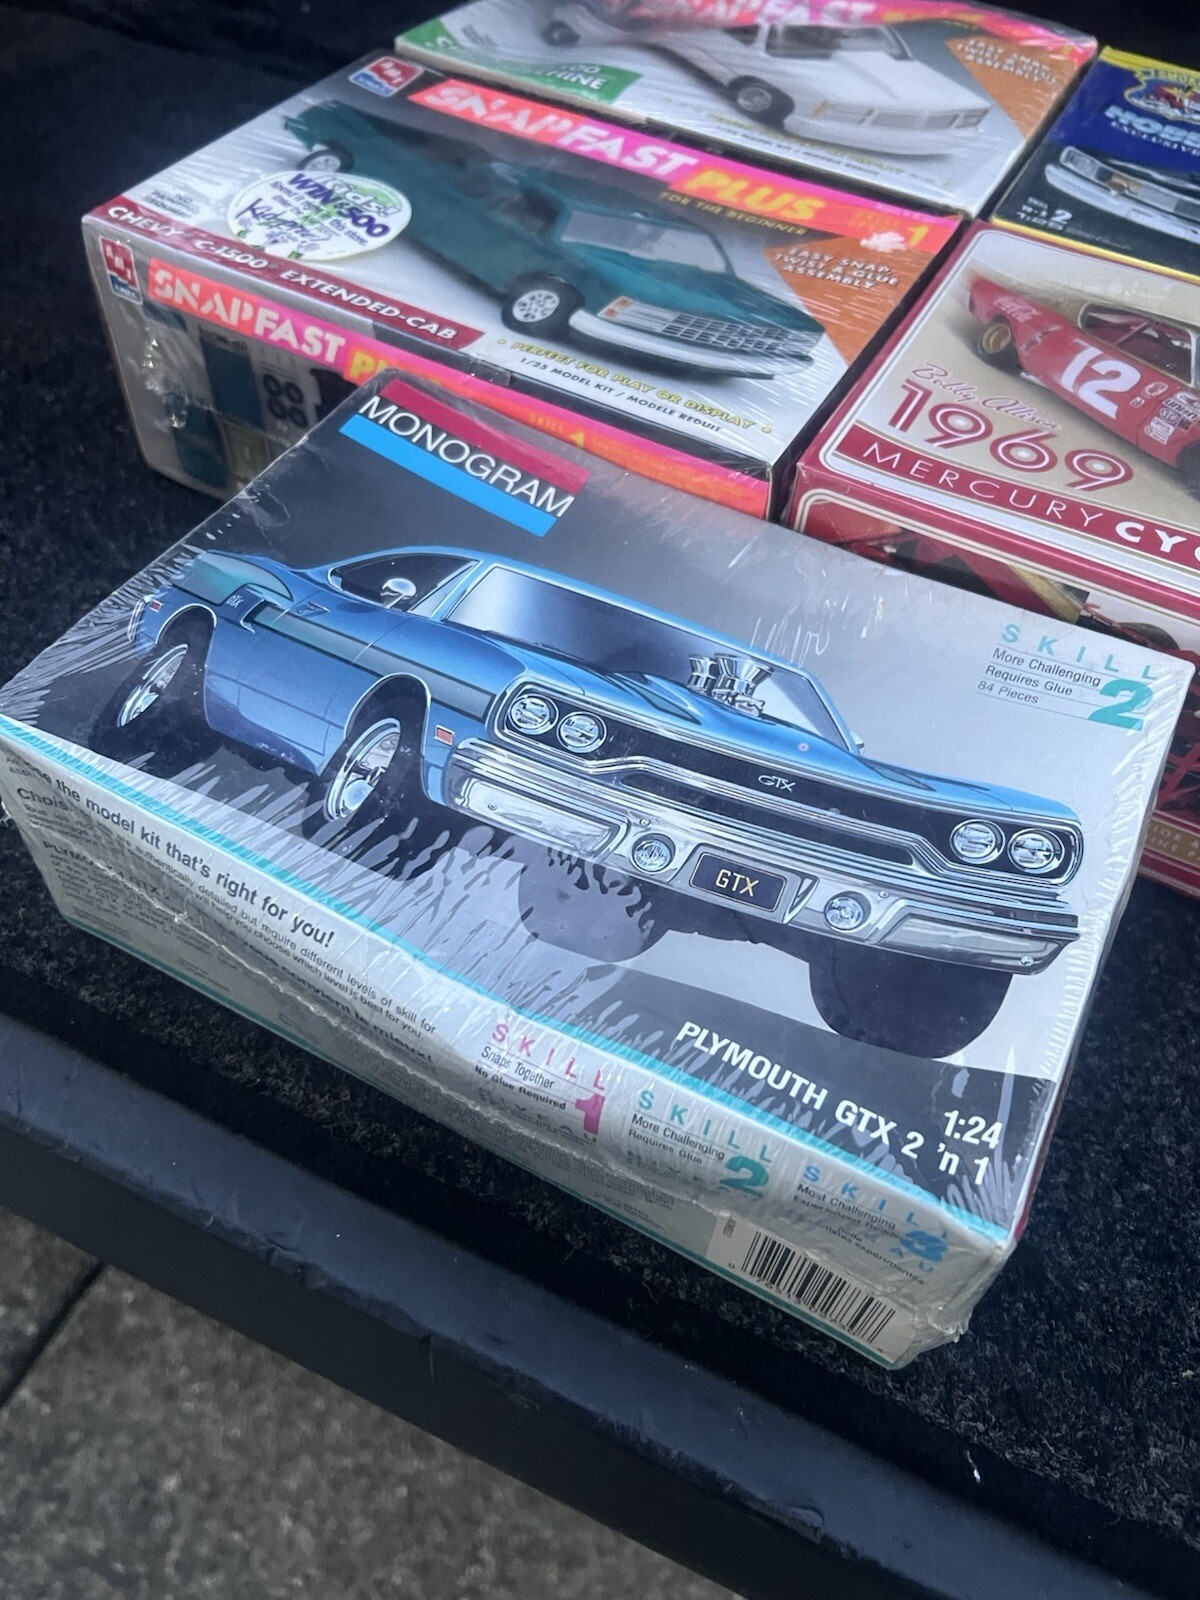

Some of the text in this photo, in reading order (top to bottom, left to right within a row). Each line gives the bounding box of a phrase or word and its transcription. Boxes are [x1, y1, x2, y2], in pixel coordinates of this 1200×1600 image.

[288, 173, 337, 205] WIN
[684, 168, 826, 221] PLUS
[108, 206, 184, 237] CHEVY
[194, 239, 270, 271] C-1500
[279, 269, 459, 342] EXTENDED-CAB
[782, 263, 879, 289] ASSEMBLY
[512, 341, 757, 431] PERFECT FOR PLAY OR DISPLAY
[520, 357, 549, 372] 1/25
[551, 367, 591, 387] MODEL
[594, 382, 615, 395] KIT
[912, 362, 1061, 432] Bobby Allison
[1061, 338, 1142, 420] 12
[358, 395, 576, 519] MONOGRAM
[888, 378, 1134, 493] 1969
[862, 441, 1200, 564] MERCURY CY
[992, 647, 1102, 688] More Challenging
[1001, 623, 1160, 682] SKILL
[977, 680, 1040, 704] 84 Pieces
[985, 664, 1154, 732] Requires Glue 2
[757, 774, 796, 792] GTX
[56, 778, 81, 802] the
[86, 797, 136, 835] model
[140, 826, 162, 850] kit
[166, 841, 212, 879] that's
[215, 871, 258, 905] right
[261, 895, 289, 921] for
[290, 915, 336, 948] you!
[715, 868, 760, 898] GTX
[198, 884, 238, 913] detailed
[241, 910, 259, 927] but
[261, 923, 297, 950] require
[300, 946, 344, 979] different
[346, 973, 377, 1000] levels
[380, 996, 393, 1009] of
[395, 1005, 418, 1024] skill
[420, 1018, 437, 1035] for
[235, 919, 252, 934] you
[253, 929, 291, 958] choose
[292, 953, 322, 977] which
[323, 973, 349, 994] level
[360, 996, 383, 1015] best
[385, 1009, 400, 1025] for
[481, 1045, 556, 1090] Snaps Together
[491, 1022, 606, 1091] SKILL
[474, 1064, 490, 1079] No
[491, 1069, 516, 1093] Glue
[518, 1085, 567, 1111] Required
[574, 1091, 606, 1136] 1
[638, 1088, 773, 1163] SKILL
[675, 1020, 830, 1111] PLYMOUTH
[834, 1099, 898, 1147] GTX
[900, 1130, 926, 1159] 2
[973, 1156, 990, 1186] 1
[943, 1109, 1004, 1150] 1:24
[628, 1128, 675, 1155] Requires
[677, 1148, 704, 1166] Glue
[719, 1154, 770, 1198] 2
[631, 1112, 661, 1135] More
[663, 1126, 727, 1161] Challenging
[796, 1183, 896, 1231] Most Challenging
